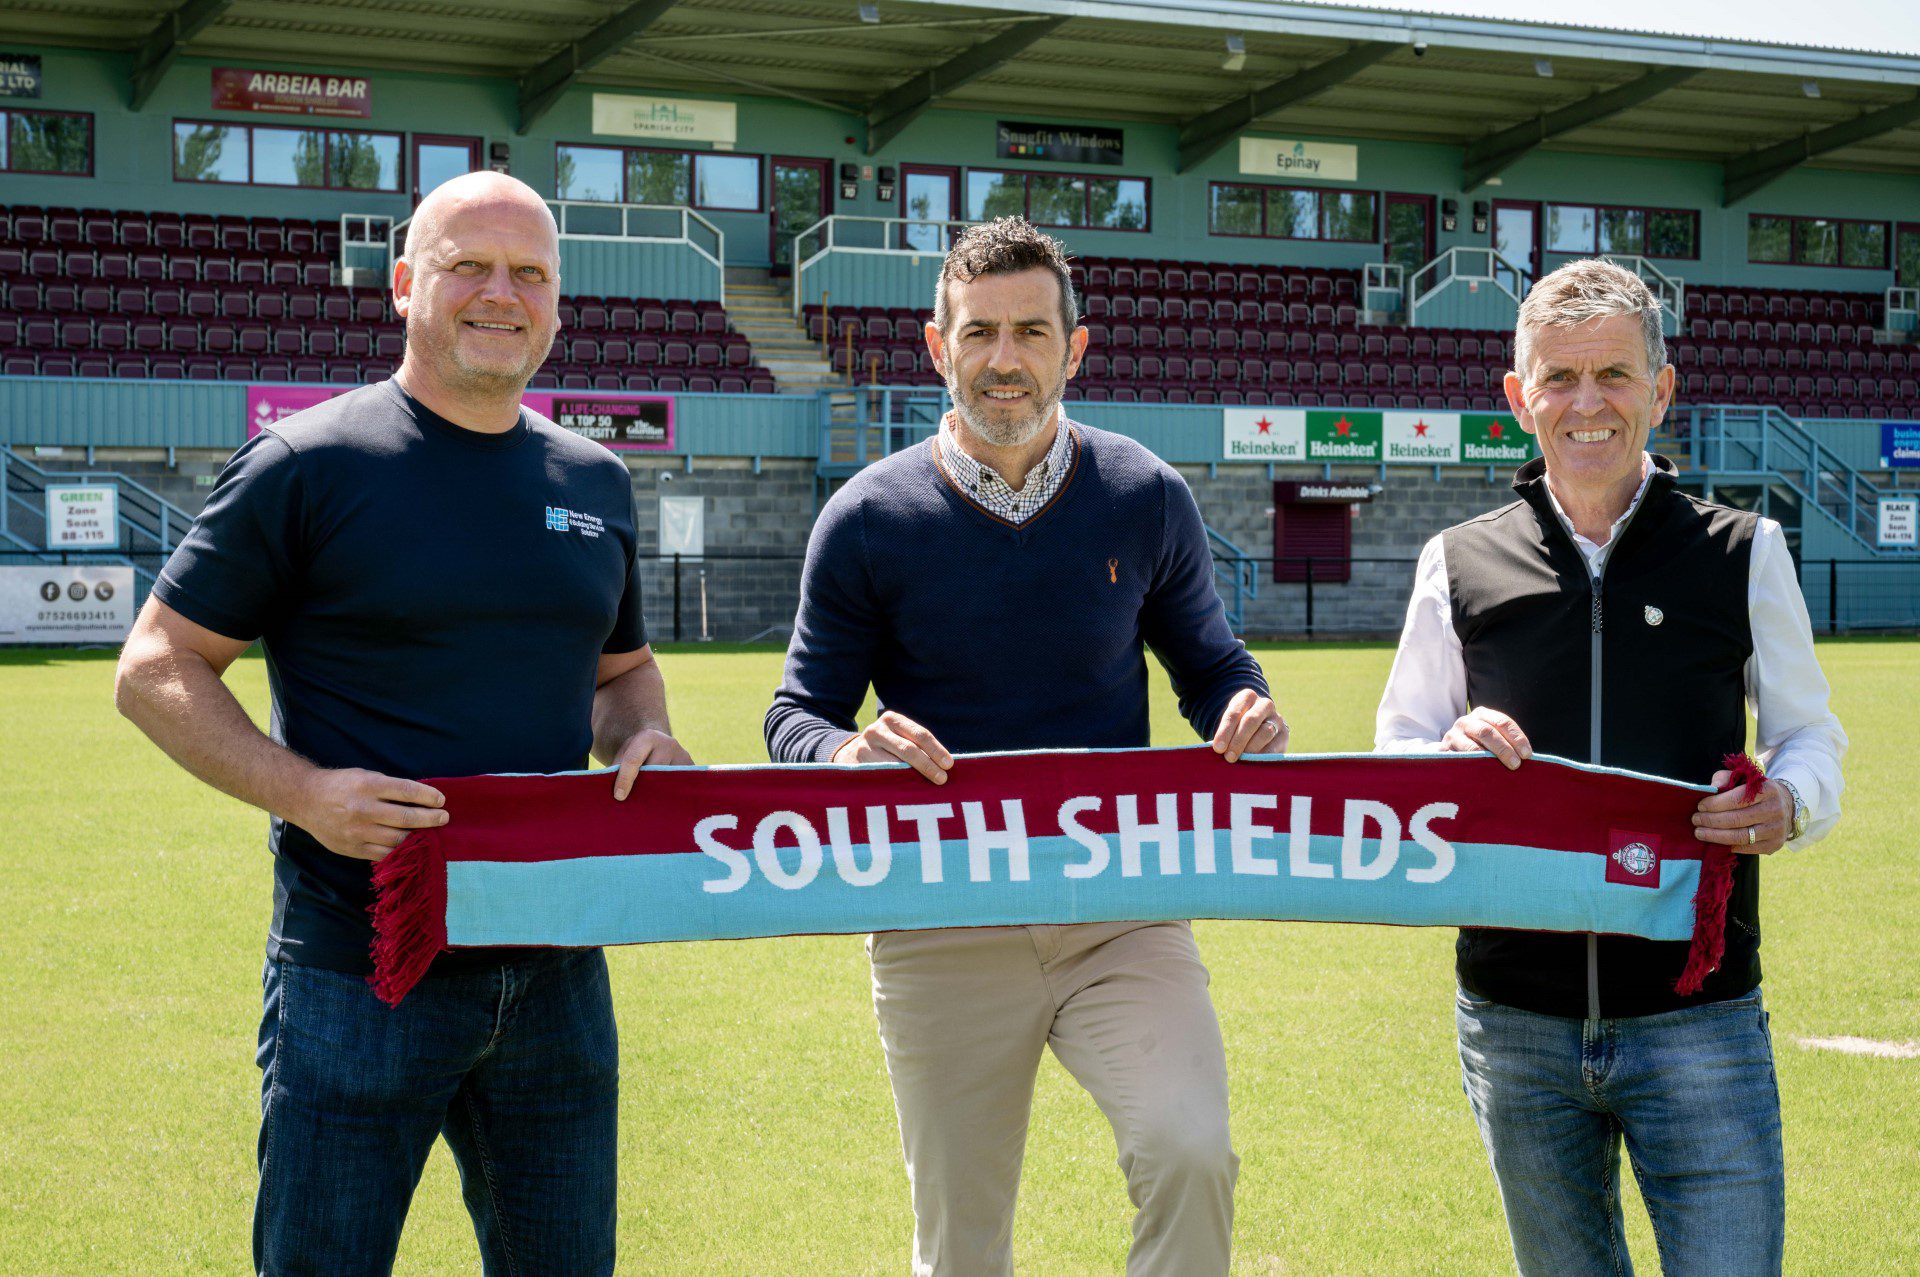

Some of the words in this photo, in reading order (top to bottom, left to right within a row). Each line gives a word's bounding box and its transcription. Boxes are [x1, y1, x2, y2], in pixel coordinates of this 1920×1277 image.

[8, 76, 35, 89] LTD
[248, 73, 322, 95] ARBEIA
[326, 78, 366, 98] BAR
[634, 122, 671, 131] SPANISH
[675, 125, 695, 133] CITY
[1000, 128, 1052, 145] Snugfit
[1060, 132, 1120, 149] Windows
[1276, 154, 1320, 172] Epinay
[561, 403, 568, 413] A
[570, 403, 640, 415] LIFE-CHANGING
[560, 415, 575, 426] UK
[577, 415, 596, 426] TOP
[598, 416, 613, 427] 50
[634, 420, 650, 430] The
[1231, 441, 1296, 456] Heineken
[1310, 441, 1376, 457] Heineken
[1390, 443, 1452, 458] Heineken
[1464, 443, 1528, 459] Heineken
[60, 493, 103, 502] GREEN
[1300, 486, 1329, 498] Drinks
[1329, 487, 1369, 498] Available
[68, 507, 96, 515] Zone
[569, 510, 584, 520] New
[583, 513, 603, 525] Energy
[66, 519, 99, 528] Seats
[581, 529, 599, 538] Solutions
[692, 798, 1031, 895] SOUTH
[1057, 791, 1460, 884] SHIELDS
